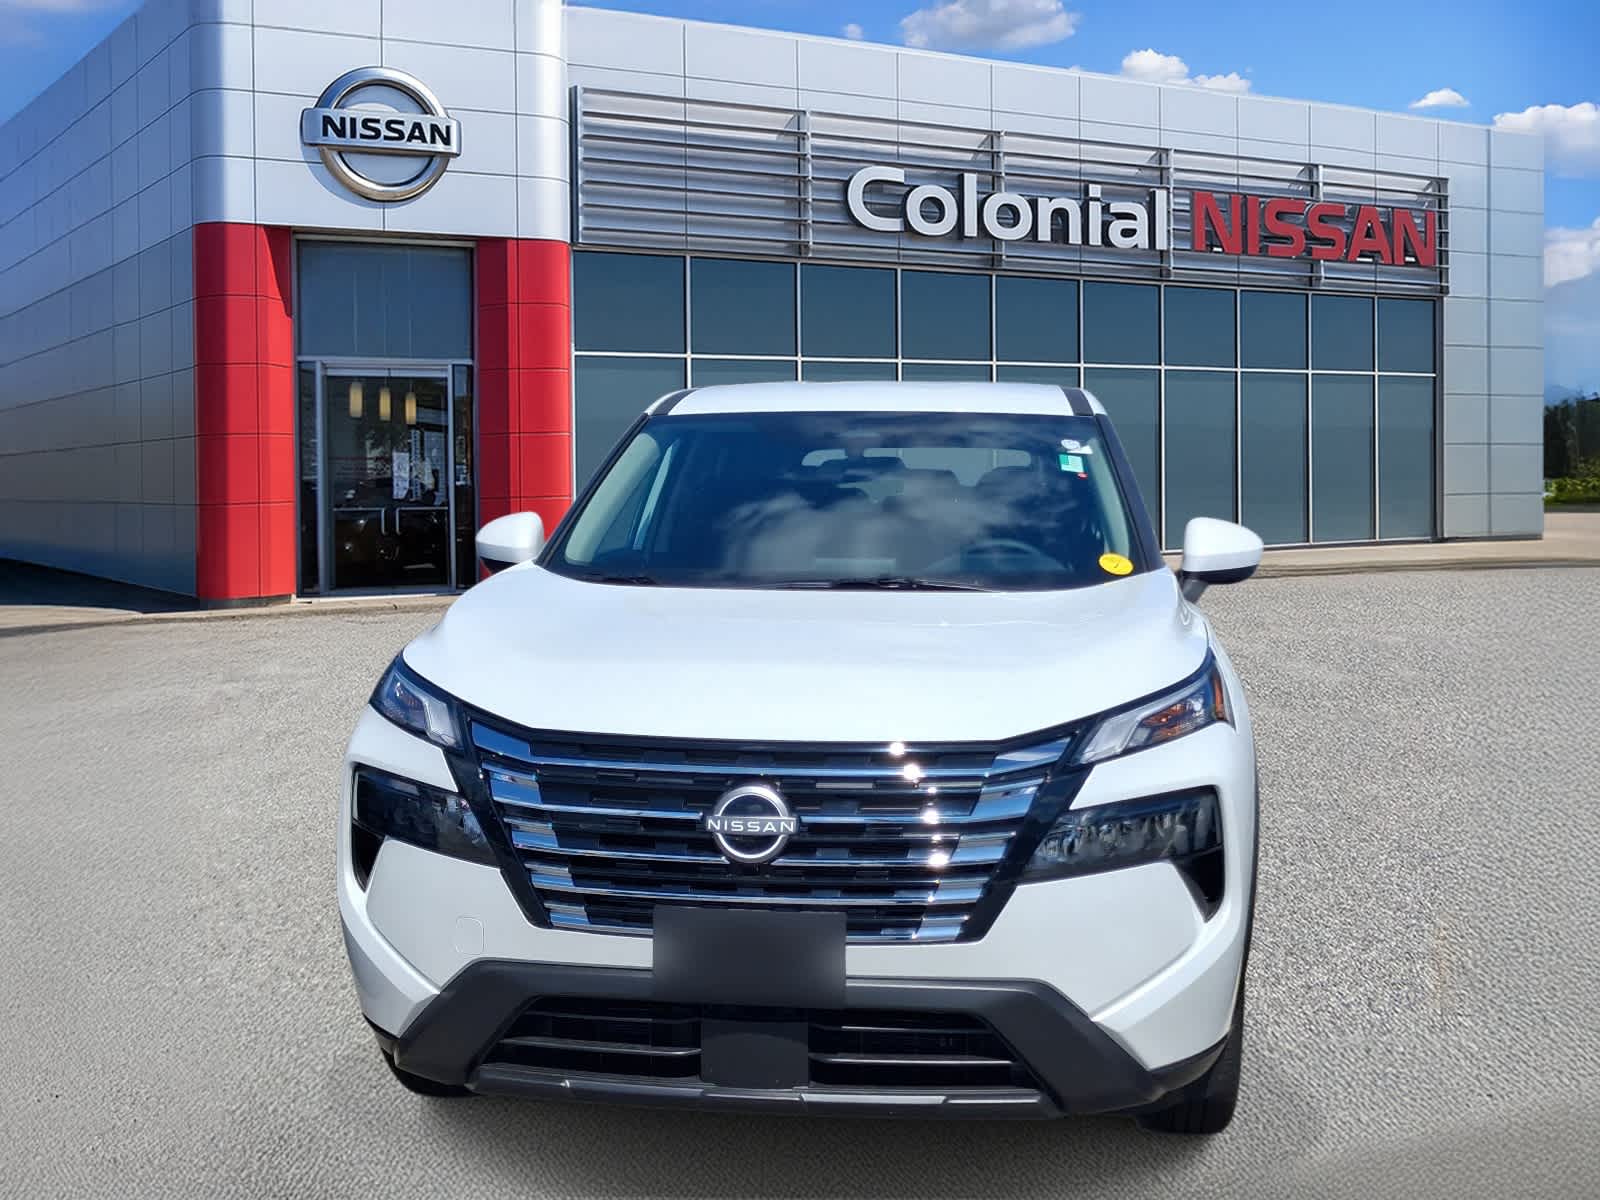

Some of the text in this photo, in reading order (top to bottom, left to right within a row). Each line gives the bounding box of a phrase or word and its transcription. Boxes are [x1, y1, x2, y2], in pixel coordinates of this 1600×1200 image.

[322, 115, 451, 146] NISSAN
[846, 166, 1436, 266] Colonial NISSAN
[707, 819, 794, 832] NISSAN
